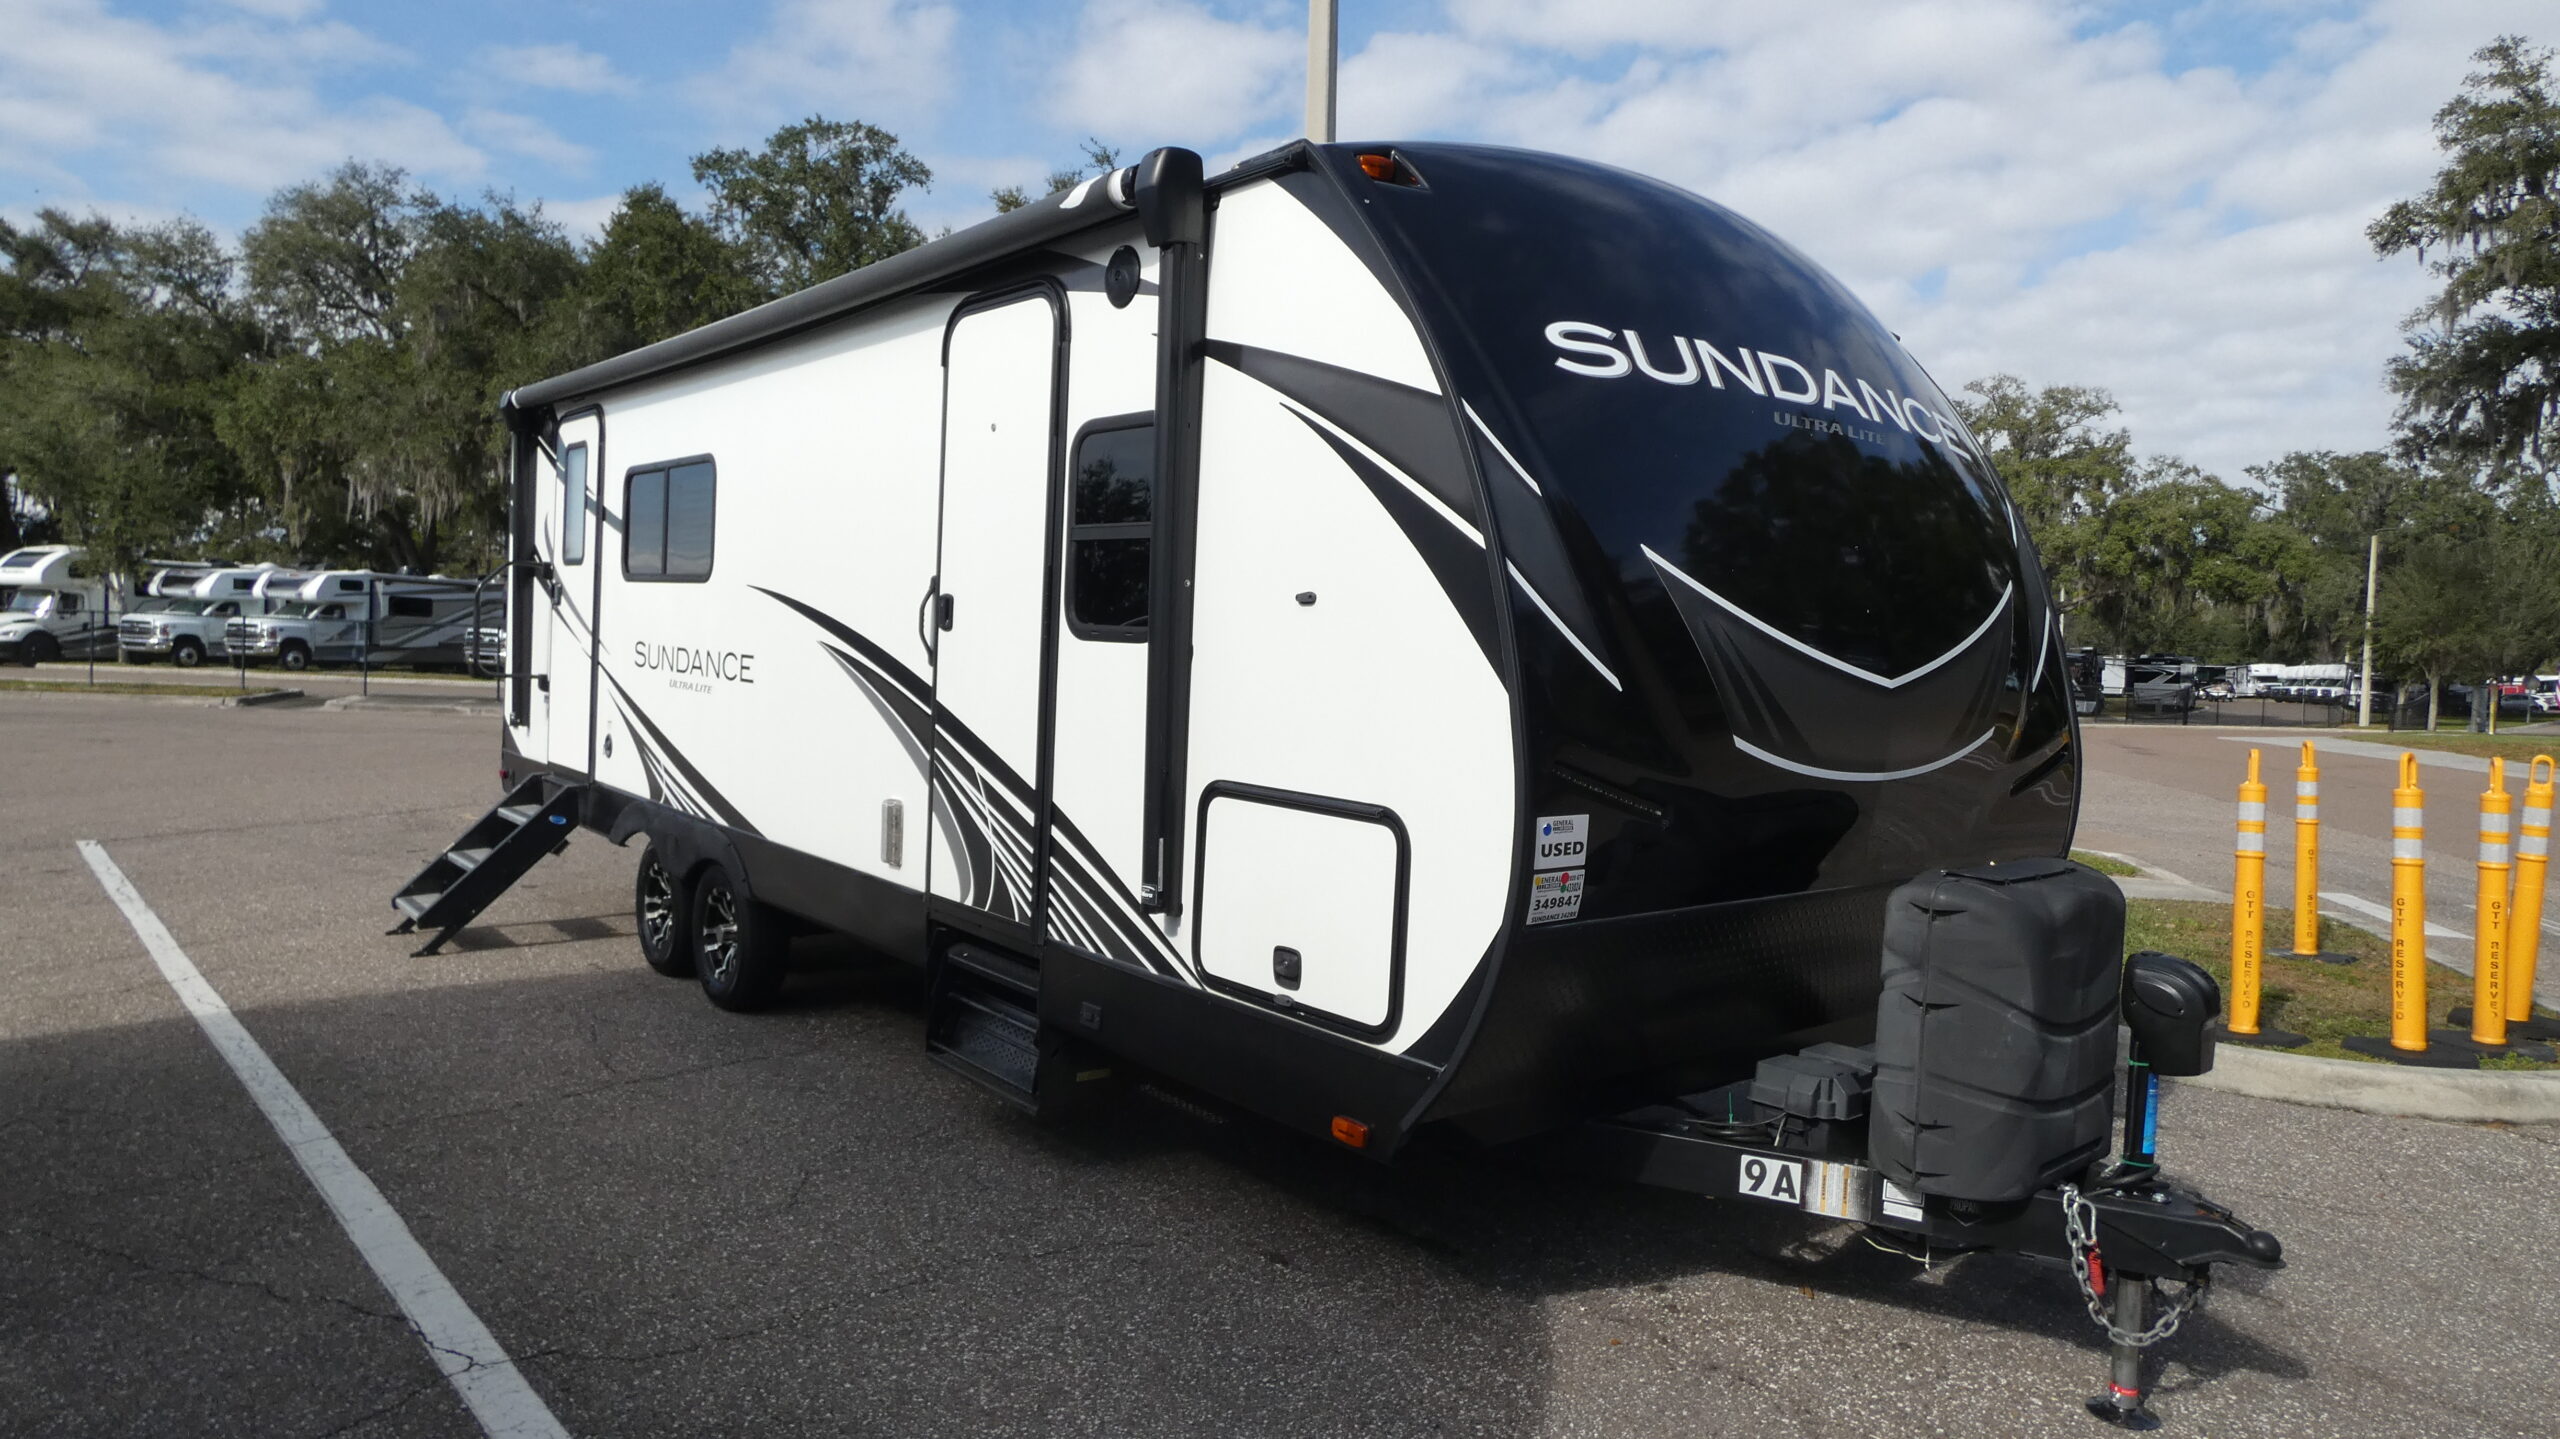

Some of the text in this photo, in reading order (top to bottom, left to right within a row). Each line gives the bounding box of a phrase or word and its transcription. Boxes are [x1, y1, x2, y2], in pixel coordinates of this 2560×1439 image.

[1544, 320, 1972, 462] SUNDANCE
[1774, 411, 1886, 445] ULTRA LITE
[634, 640, 755, 684] SUNDANCE
[669, 679, 713, 694] ULTRA LITE
[1541, 841, 1585, 858] USED
[1533, 895, 1581, 911] 349847
[2246, 890, 2255, 918] GTT
[2396, 898, 2405, 927] GTT
[2491, 901, 2501, 929] GTT
[1531, 913, 1560, 923] SUNDANCE
[2396, 939, 2404, 1020] RESERVED
[1745, 1158, 1798, 1201] 9A
